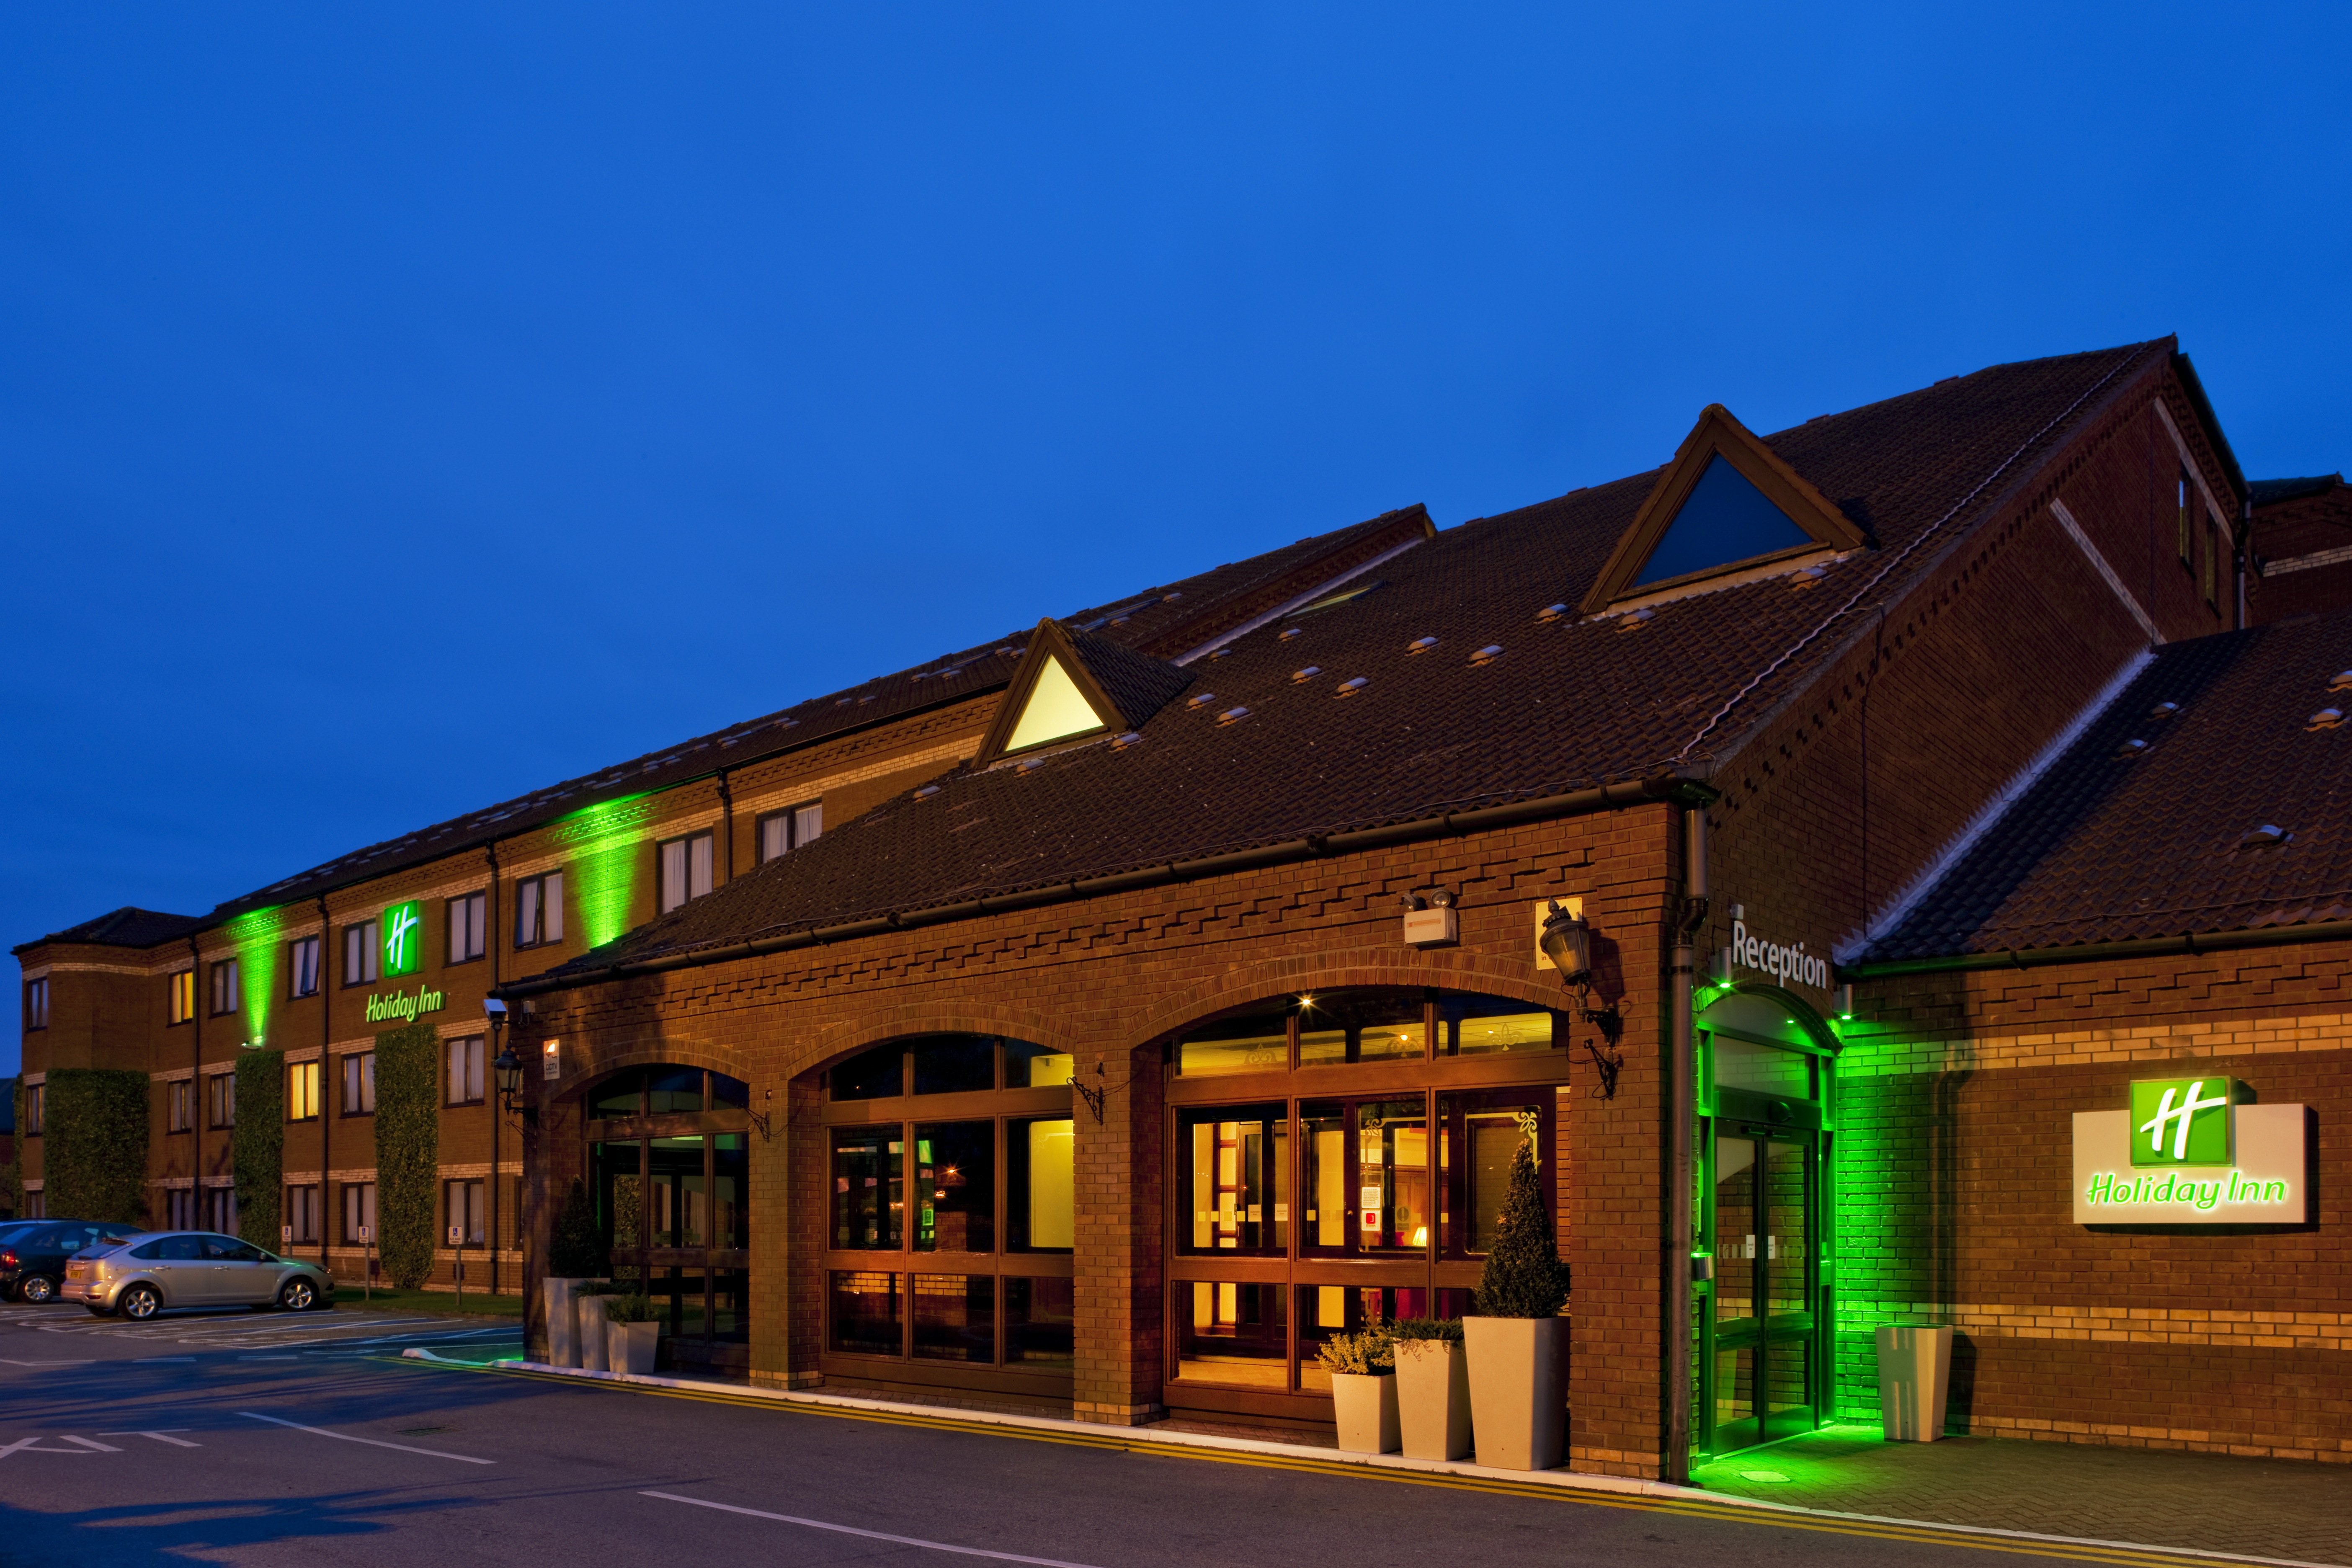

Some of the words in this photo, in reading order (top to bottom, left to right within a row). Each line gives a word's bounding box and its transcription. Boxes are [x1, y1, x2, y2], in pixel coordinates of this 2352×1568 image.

[1733, 921, 1826, 989] Reception
[366, 990, 418, 1022] Holiday
[418, 985, 441, 1013] Inn
[2087, 1173, 2222, 1210] Holiday
[2226, 1171, 2286, 1202] Inn
